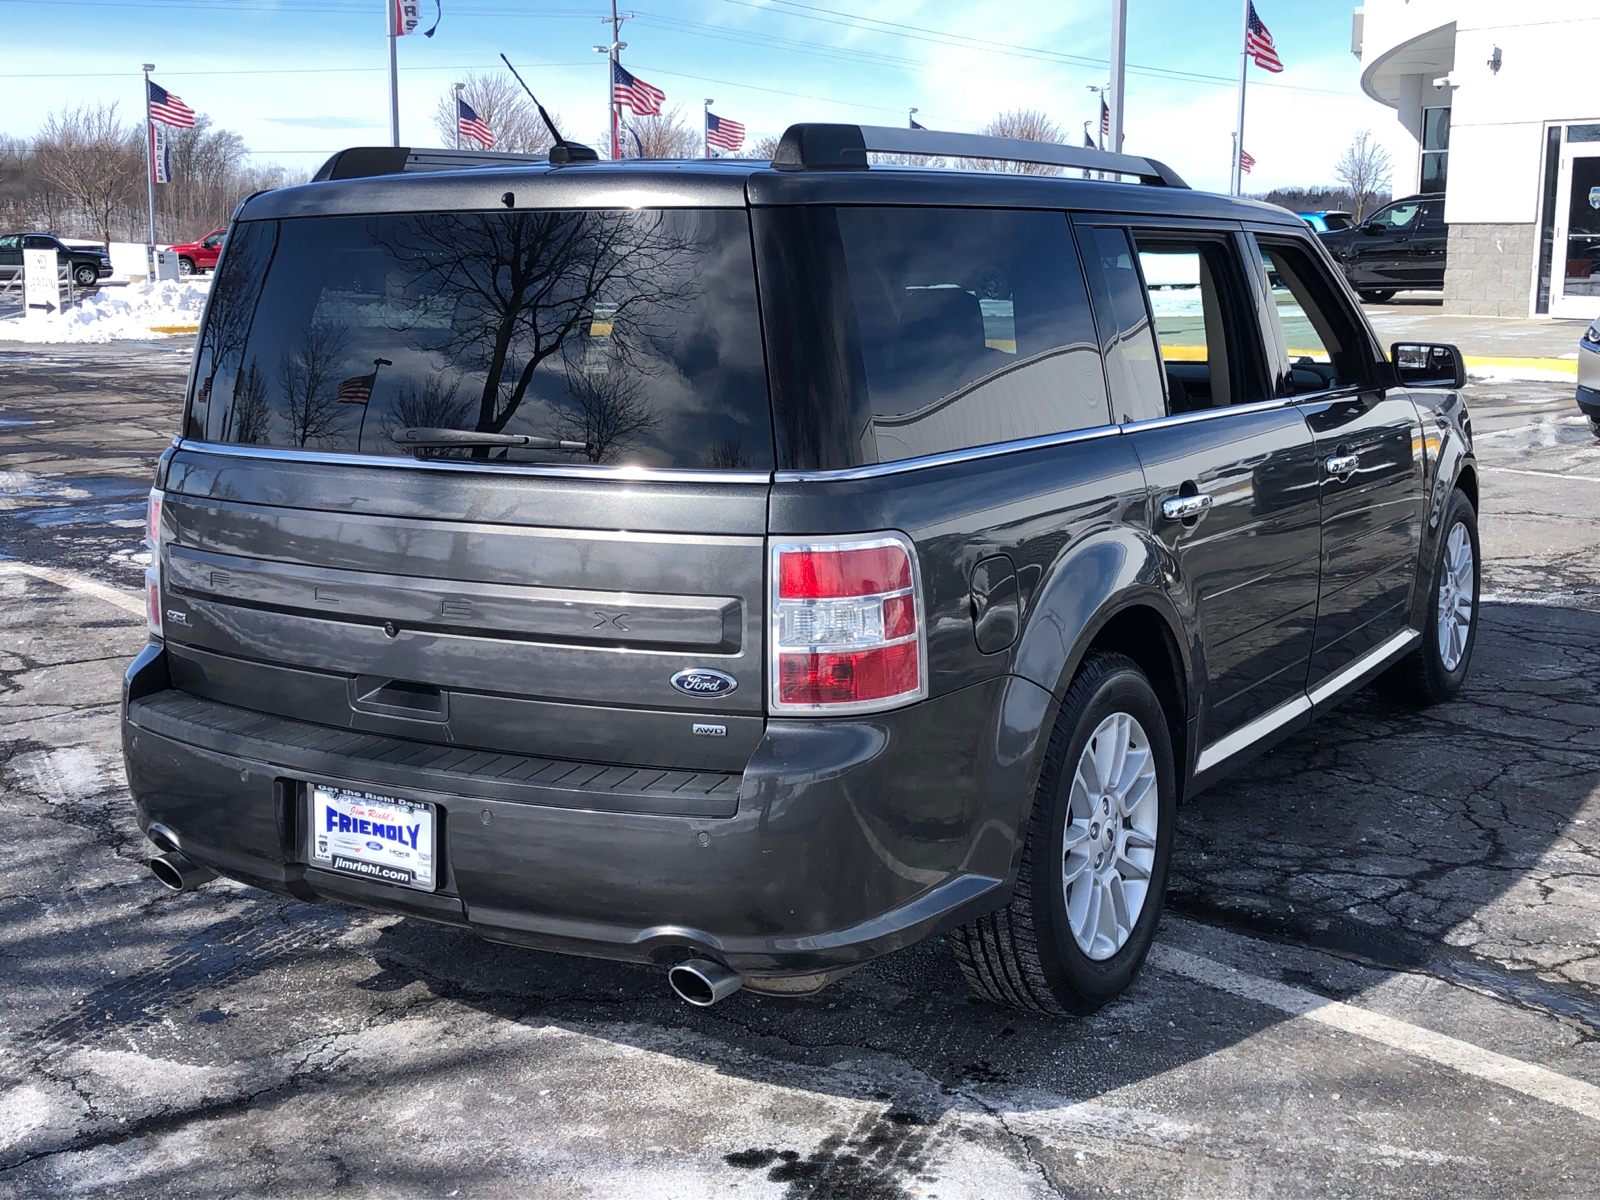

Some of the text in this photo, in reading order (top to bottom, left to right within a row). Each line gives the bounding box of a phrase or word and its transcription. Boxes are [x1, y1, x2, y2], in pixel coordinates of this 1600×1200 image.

[210, 571, 630, 632] FLEX
[683, 674, 721, 692] Ford
[695, 726, 724, 736] AWD
[317, 785, 340, 794] Get
[342, 787, 362, 797] the
[365, 792, 395, 803] Riehl
[398, 799, 425, 810] Deal
[349, 806, 365, 816] Jim
[367, 808, 395, 822] Riehl's
[326, 804, 421, 851] FRIENDLY
[334, 857, 409, 882] jimriehl.com
